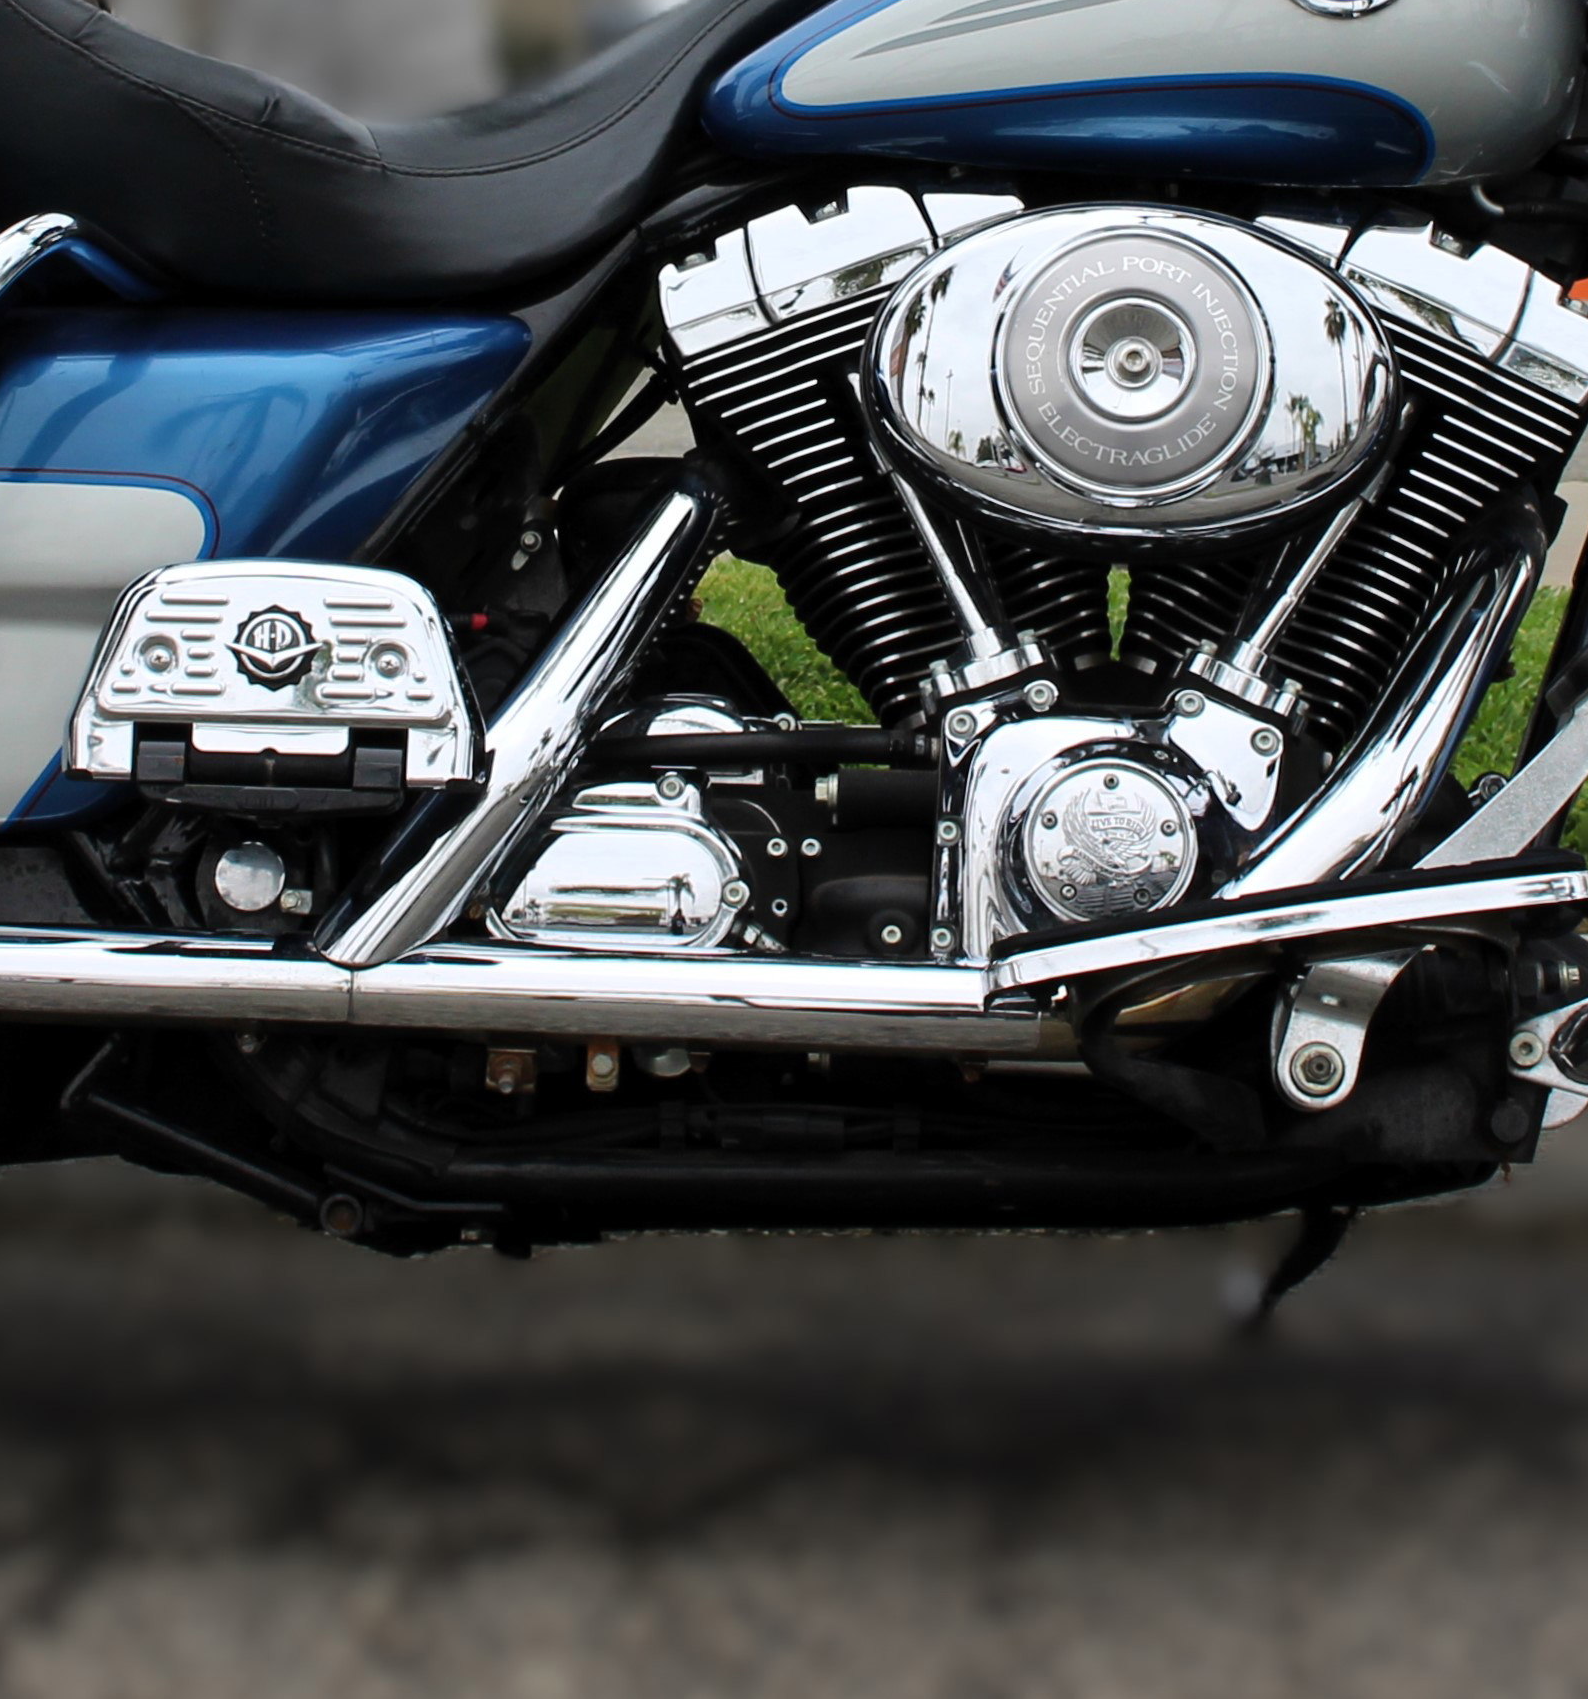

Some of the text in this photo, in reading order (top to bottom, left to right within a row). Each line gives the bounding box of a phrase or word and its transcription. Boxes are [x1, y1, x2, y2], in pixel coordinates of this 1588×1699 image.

[1025, 255, 1239, 412] SEQUENTIAL PORT INJECTION
[1091, 817, 1112, 829] LIVE
[1113, 816, 1125, 825] TO
